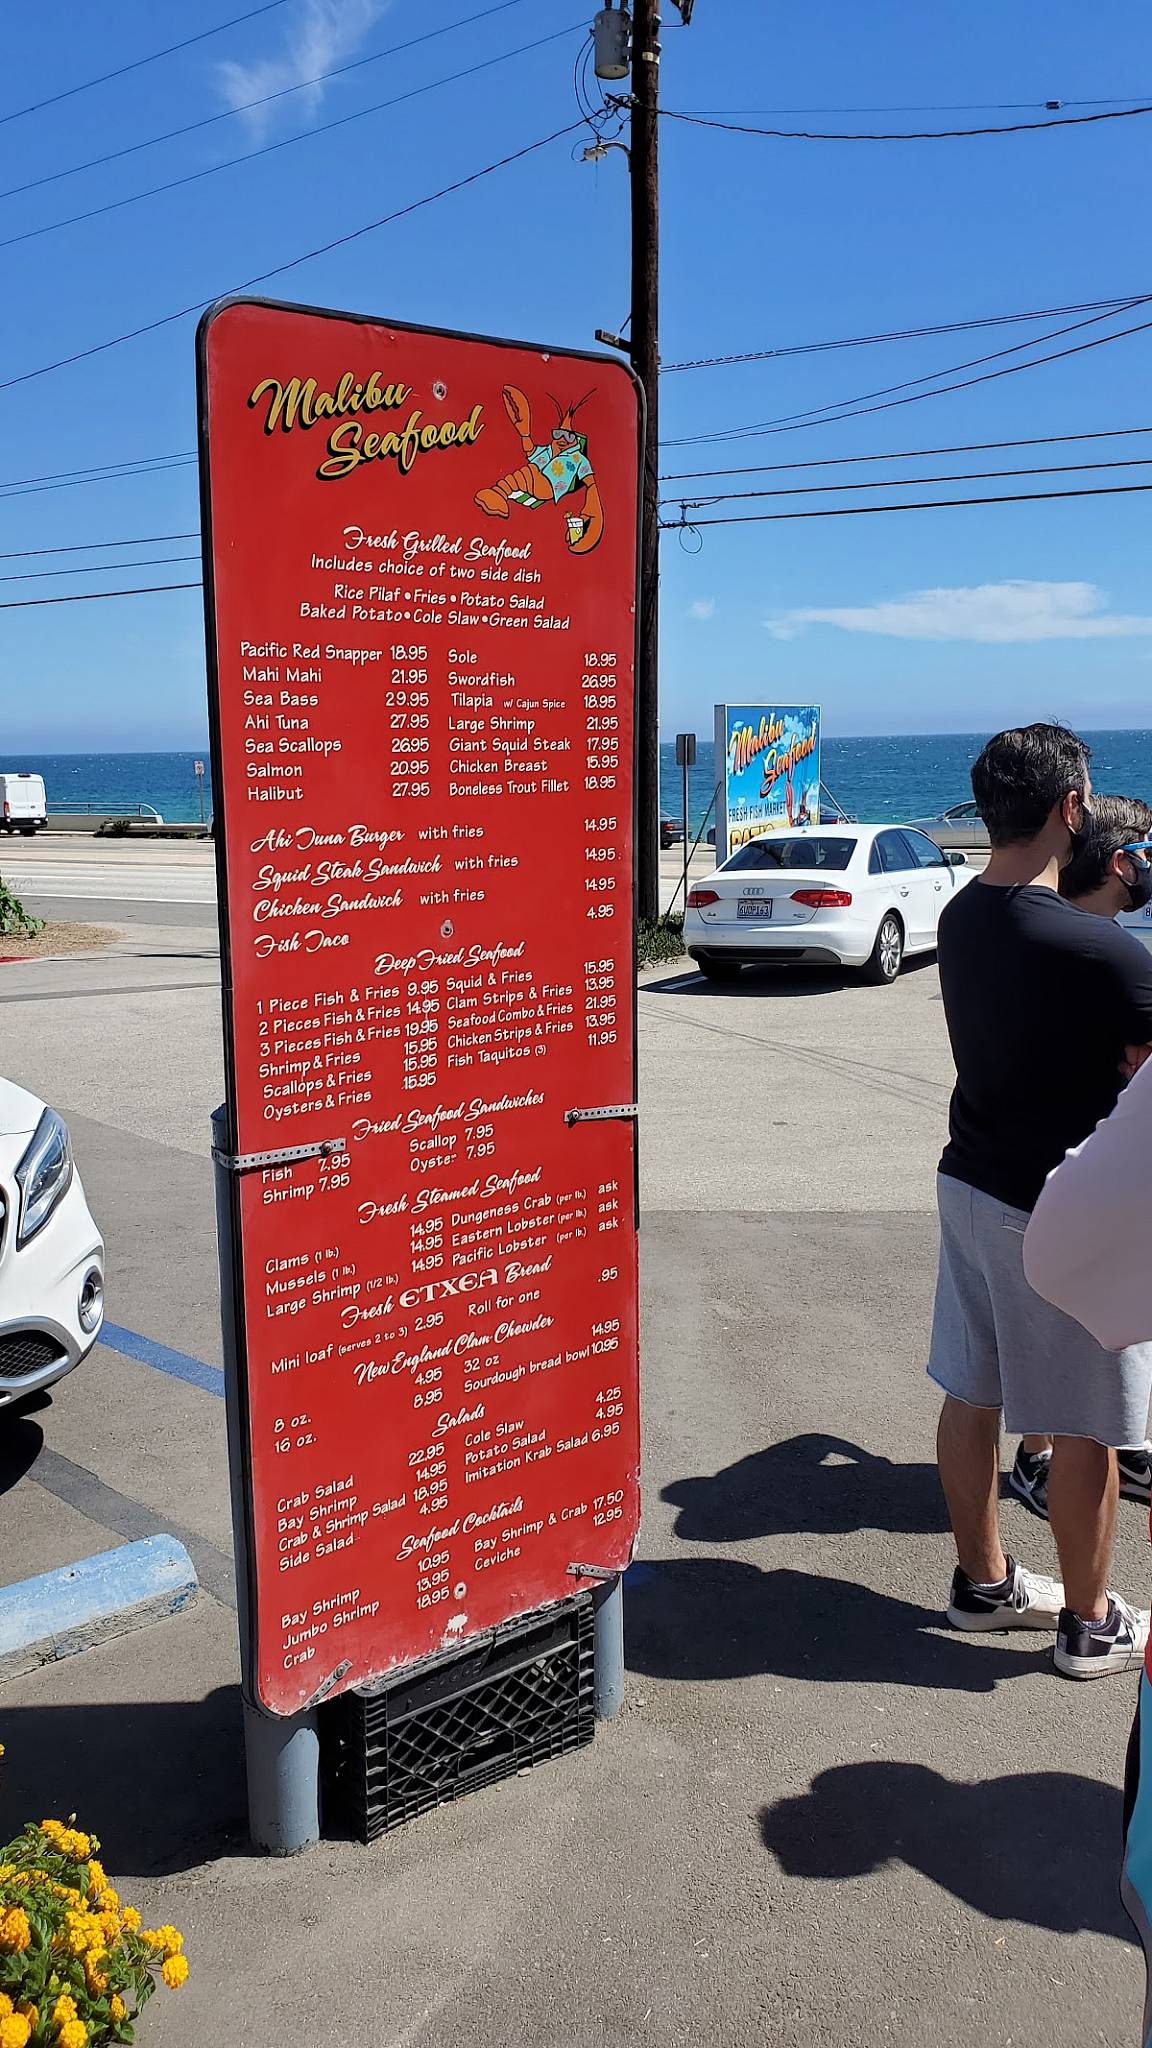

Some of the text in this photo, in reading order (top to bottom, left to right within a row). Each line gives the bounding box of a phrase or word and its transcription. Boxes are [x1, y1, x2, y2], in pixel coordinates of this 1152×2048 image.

[249, 372, 486, 481] Malibu Seafood
[311, 554, 541, 583] Includes choice of two side dish
[343, 526, 532, 570] Fresh Grilled Seafood
[241, 641, 427, 665] Pacific Red Snapper 18.95
[243, 666, 427, 684] Mahi Mahi 21.95
[448, 649, 616, 666] Sole 18.95
[243, 690, 429, 707] Sea Bass 29.95
[448, 672, 616, 688] Swordfish 26.95
[451, 693, 616, 712] Tilapia w/ Cajun Spice 18.95
[245, 714, 429, 729] Ahi Tuna 27.95
[448, 716, 618, 734] Large Shrimp 21.95
[247, 761, 429, 777] Salmon 20.95
[728, 712, 817, 798] Malibu Seafood
[251, 817, 617, 852] Ahi Tuna Burger with fries 14.95
[729, 800, 786, 824] FRESH FISH MARKET
[254, 905, 614, 958] Fish Taco 4.95
[375, 941, 525, 976] Deep Fried Seafood
[446, 959, 614, 993] Squid & Fries 15.95
[257, 980, 438, 1014] 1 Piece Fish & Fries 9.95
[448, 995, 616, 1029] Seafood Combo & Fries 21.95
[264, 1072, 436, 1120] Oysters & Fries 15.95
[352, 1089, 544, 1141] Fried Seafood Sandwiches
[262, 1167, 293, 1183] Fish
[358, 1167, 542, 1224] Fresh Steamed Seafood
[452, 1180, 618, 1226] Dungeness Crab (per lb.) ask
[266, 1217, 443, 1273] Clams (1 lb.) 14.95
[267, 1253, 443, 1317] Large Shrimp (1/2 lb.) 14.95
[341, 1295, 394, 1328] Fresh
[505, 1255, 552, 1283] Bread
[469, 1267, 617, 1316] Roll for one .95
[272, 1312, 444, 1373] Mini loaf (serves 2 to 3) 2.95
[353, 1314, 554, 1385] New England Clam Chowder
[464, 1319, 619, 1373] 32 oz 14.95
[274, 1367, 442, 1433] 8 oz. 4.95
[432, 1403, 485, 1438] Salads
[465, 1387, 621, 1447] Cole Slaw 4.25
[277, 1442, 445, 1513] Crab Salad 22.95
[279, 1479, 447, 1551] Crab & Shrimp Salad 18.95
[396, 1496, 524, 1561] Seafood Cocktails
[474, 1490, 624, 1553] Bay Shrimp & Crab 17.50
[475, 1506, 622, 1571] Ceviche 12.95
[281, 1551, 449, 1629] Bay Shrimp 10.95
[283, 1570, 449, 1650] Jumbo Shrimp 13.95
[284, 1587, 449, 1669] Crab 18.95
